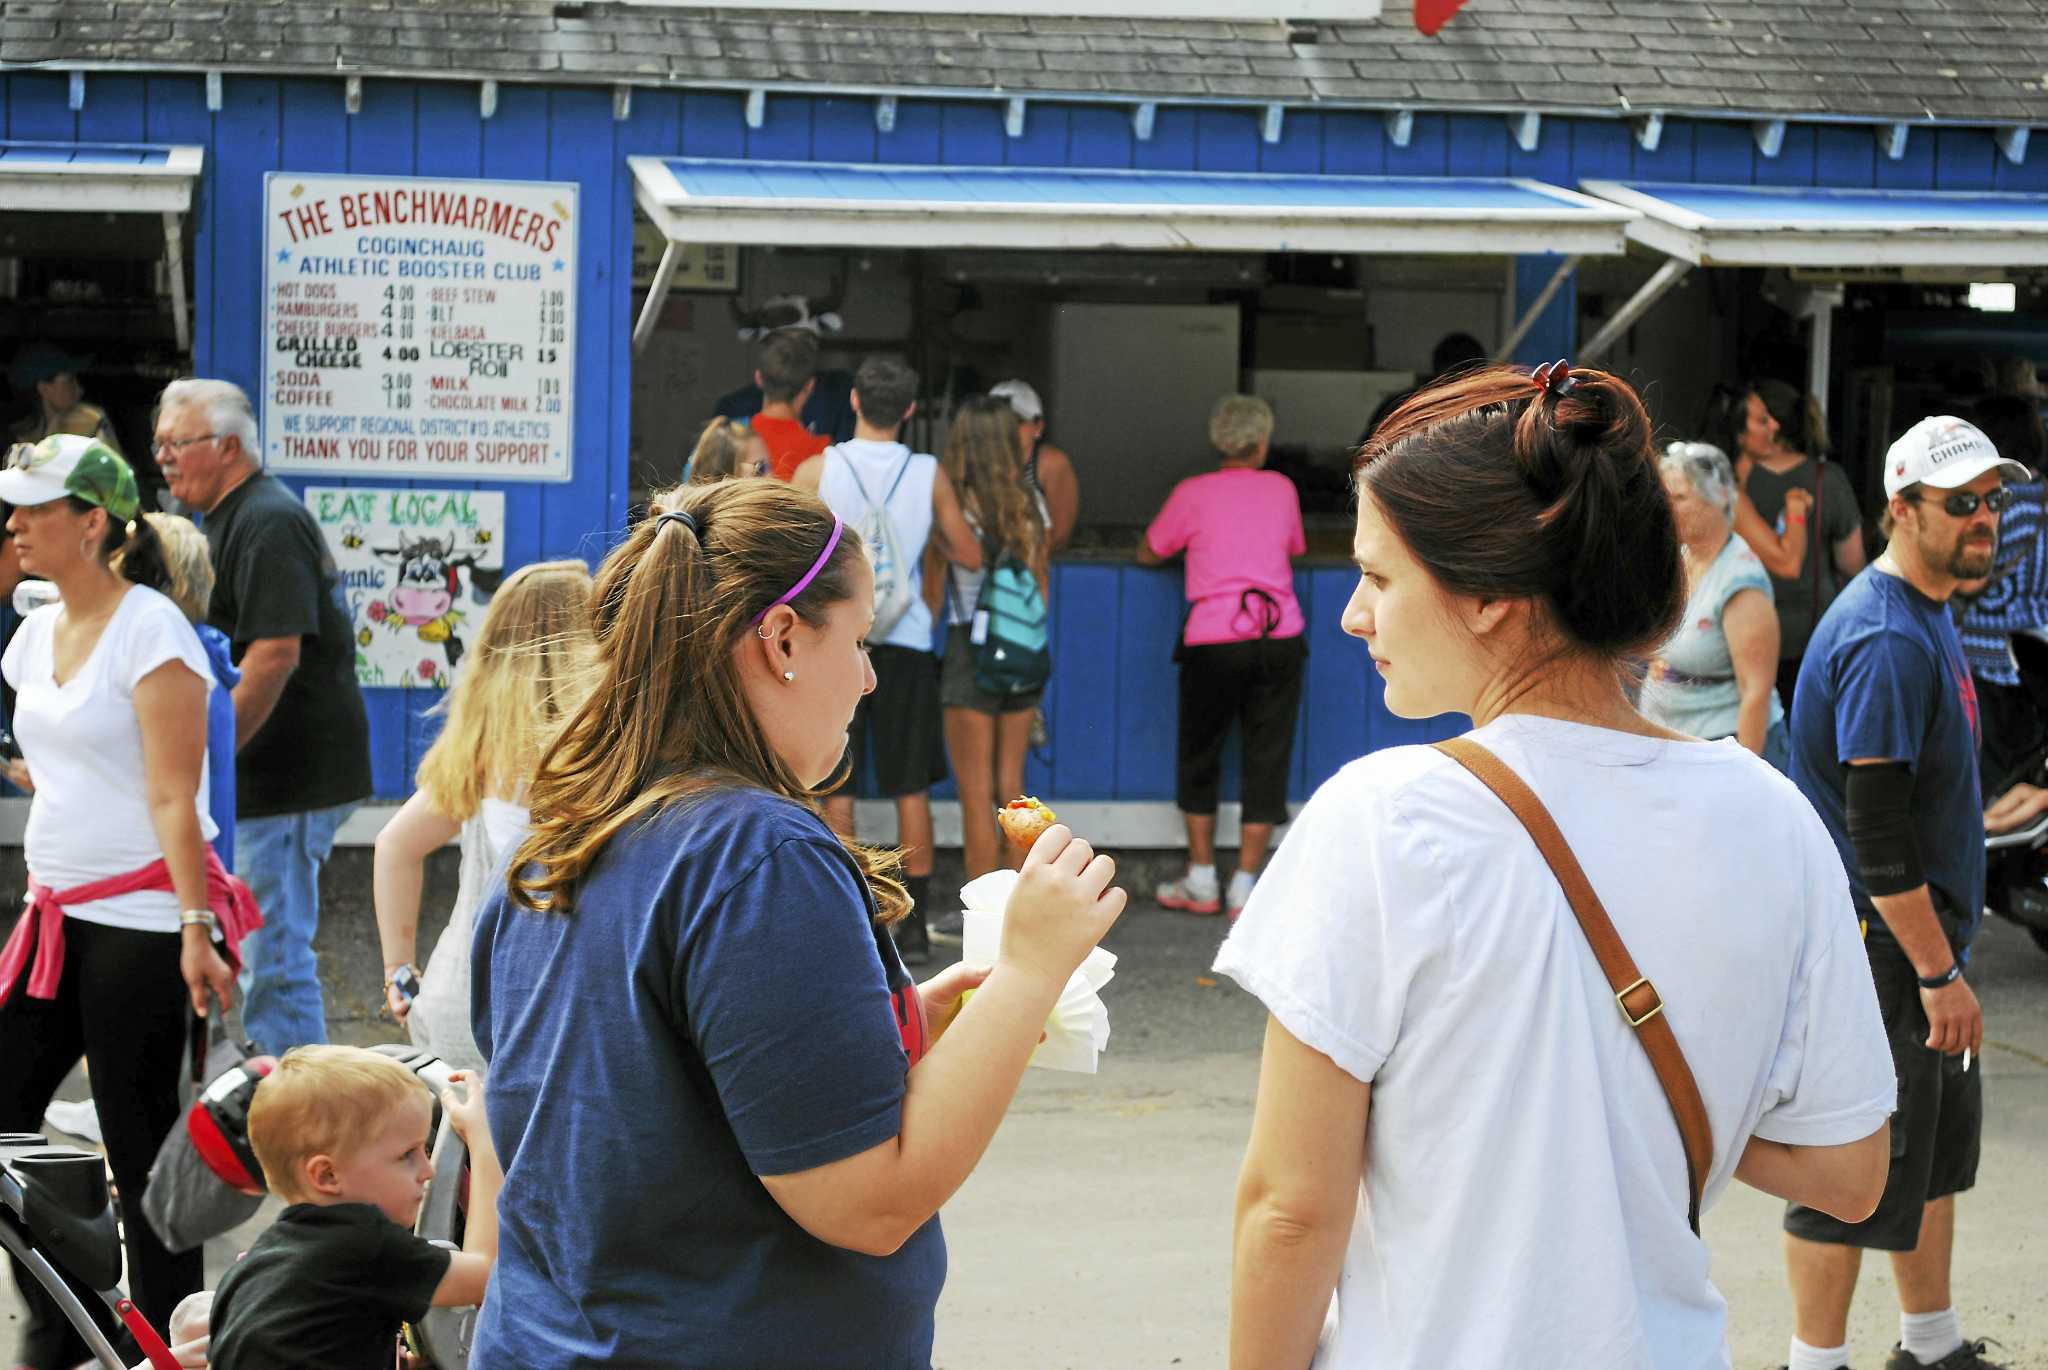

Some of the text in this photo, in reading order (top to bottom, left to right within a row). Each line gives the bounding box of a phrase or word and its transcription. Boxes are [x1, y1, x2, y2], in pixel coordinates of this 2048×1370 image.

[279, 190, 561, 252] THE BENCHWARMERS
[357, 236, 484, 257] COGINCHAUG
[299, 255, 541, 281] ATHLETIC BOOSTER CLUB
[277, 282, 300, 298] HOT
[304, 282, 336, 299] DOGS
[431, 287, 458, 303] BEEF
[463, 288, 497, 304] STEW
[277, 302, 359, 319] HAMBURGERS
[277, 319, 320, 336] CHEESE
[324, 321, 379, 338] BURGERS
[431, 325, 487, 341] KIELBASA
[276, 335, 359, 352] GRILLED
[430, 341, 523, 361] LOBSTER
[295, 351, 362, 369] CHEESE
[276, 370, 321, 387] SODA
[431, 375, 469, 391] MILK
[275, 388, 334, 407] COFFEE
[430, 394, 497, 411] CHOCOLATE
[501, 396, 528, 412] MILK
[283, 415, 301, 433] WE
[305, 414, 357, 433] SUPPORT
[361, 415, 416, 435] REGIONAL
[493, 419, 550, 439] ATHLETICS
[283, 435, 550, 465] THANK YOU FOR YOUR SUPPORT
[319, 491, 478, 525] EAT LOCAL
